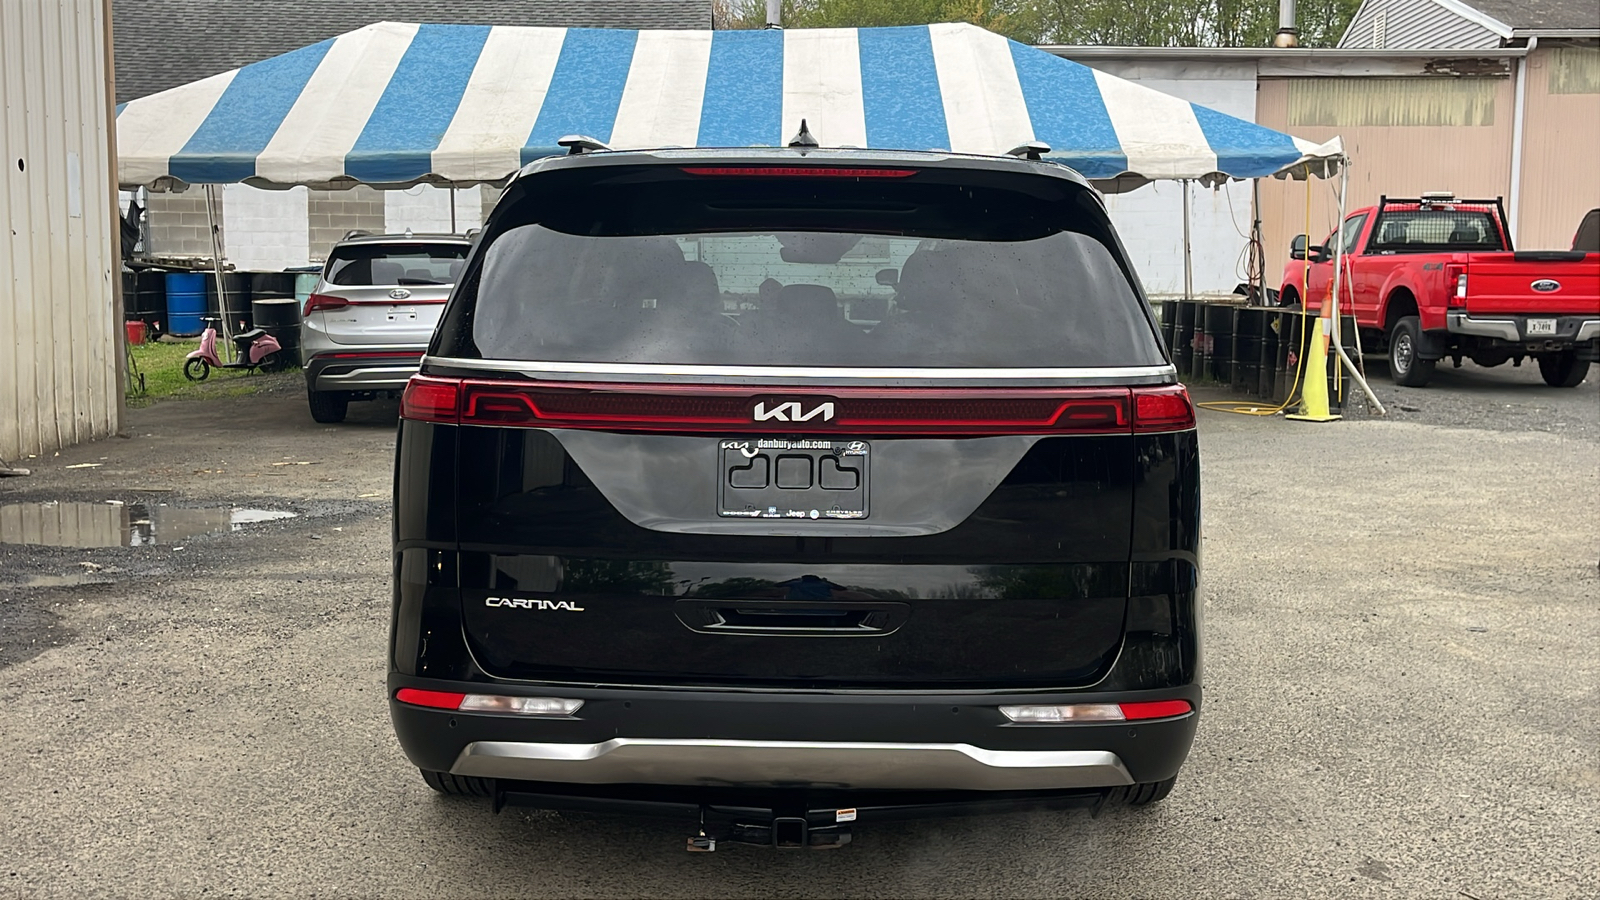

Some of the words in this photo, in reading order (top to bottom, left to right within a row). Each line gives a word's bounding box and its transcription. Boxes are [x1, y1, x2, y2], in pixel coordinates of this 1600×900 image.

[754, 402, 834, 422] KIA
[757, 438, 831, 450] danburyauto.com
[785, 509, 806, 518] Jeep
[485, 597, 585, 611] CARNIVAL
